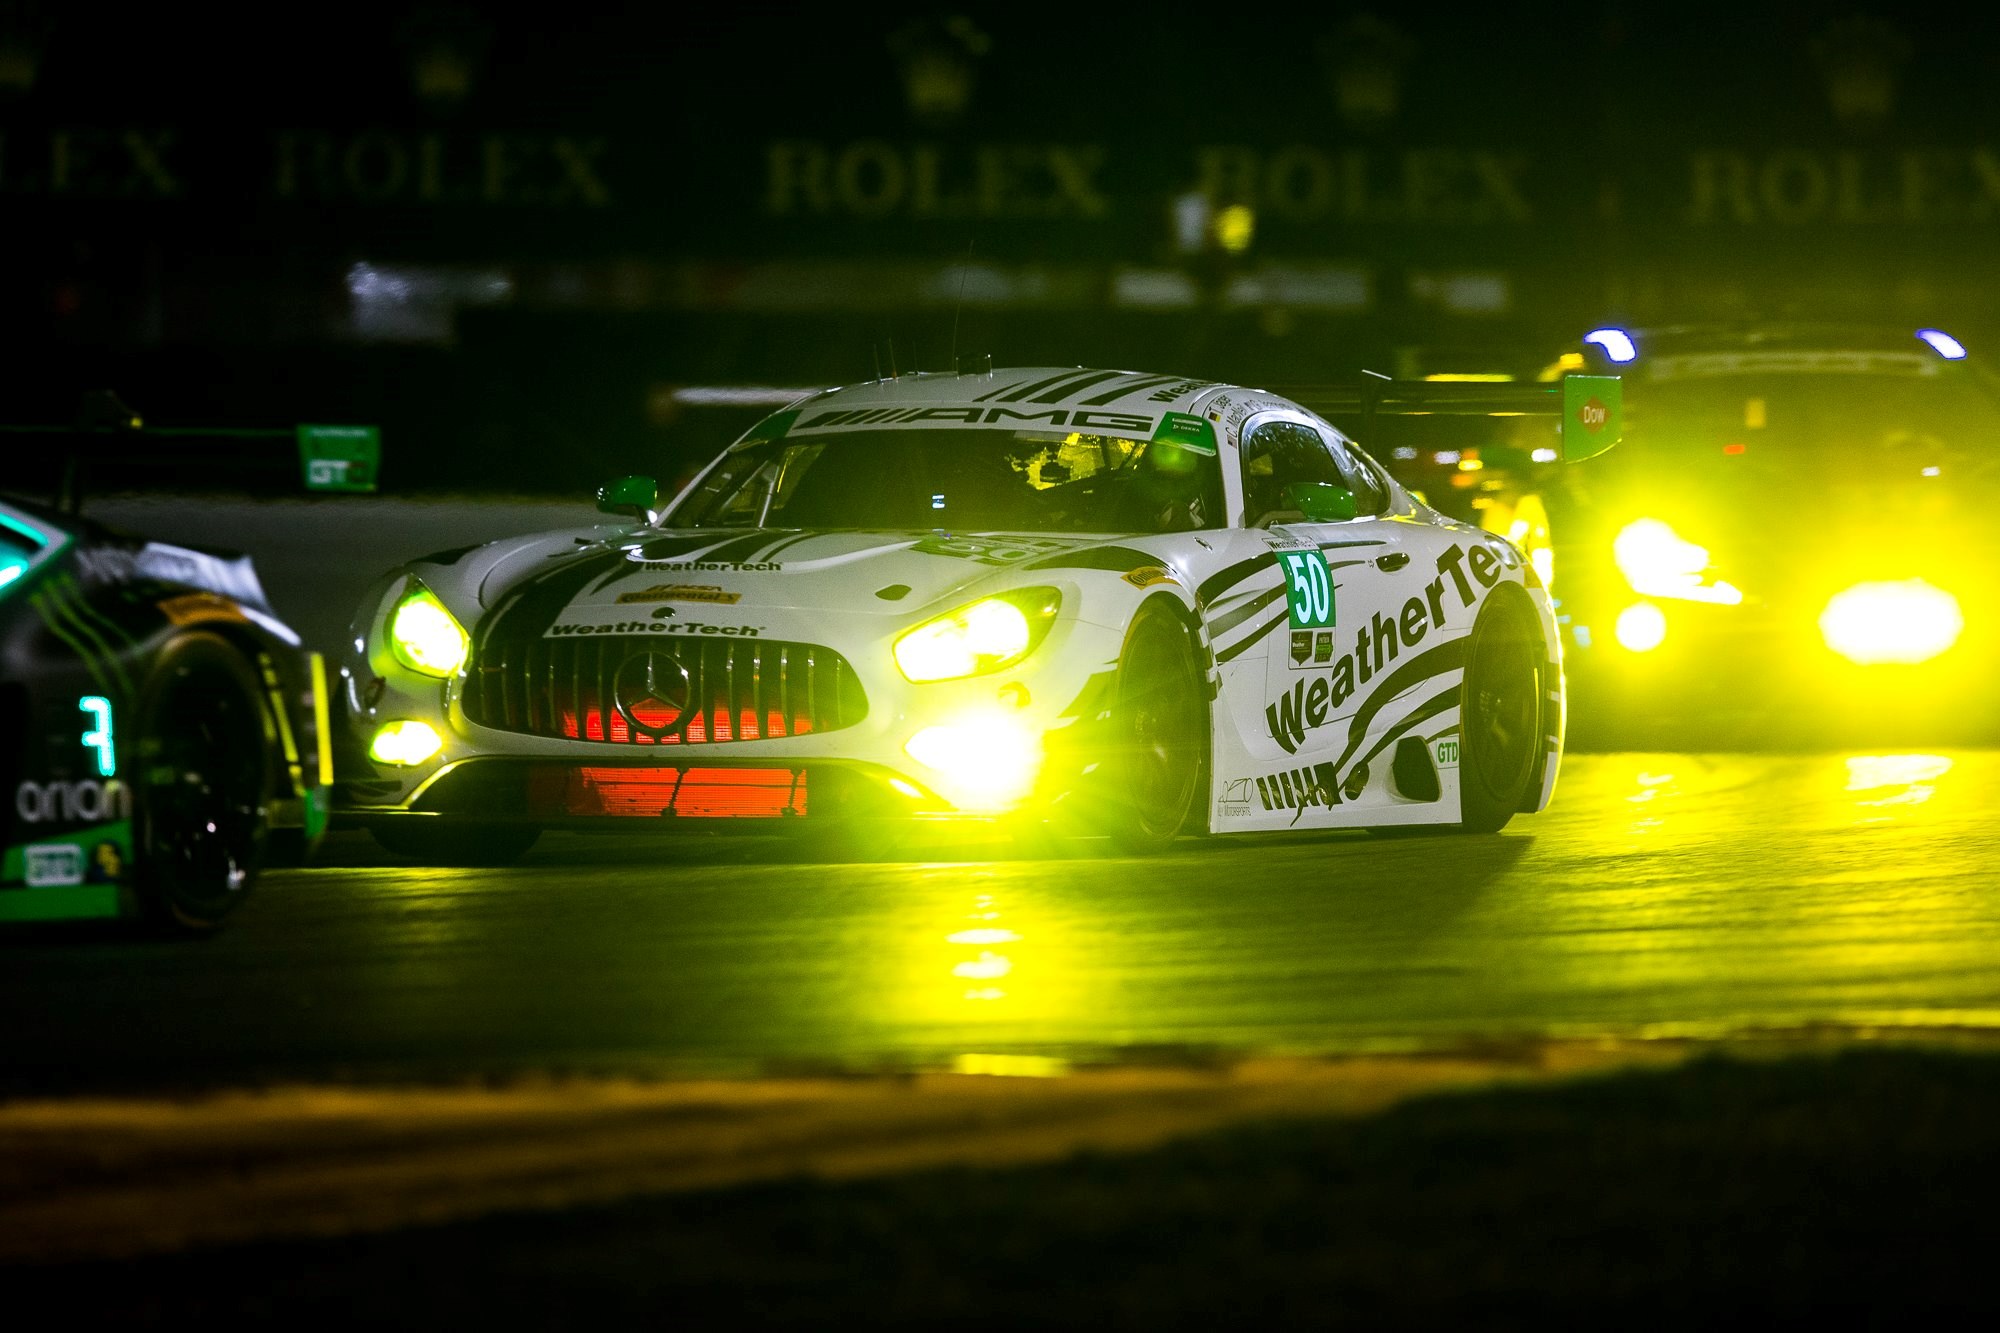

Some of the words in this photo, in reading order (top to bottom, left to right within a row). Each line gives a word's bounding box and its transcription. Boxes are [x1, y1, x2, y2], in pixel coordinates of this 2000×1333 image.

[274, 131, 611, 206] ROLEX
[766, 140, 1107, 215] ROLEX
[1197, 147, 1532, 221] ROLEX
[896, 407, 1154, 433] AMG
[645, 561, 782, 572] WeatherTech
[1287, 553, 1329, 624] 50
[551, 620, 763, 636] WeatherTech
[1437, 742, 1459, 764] GTD
